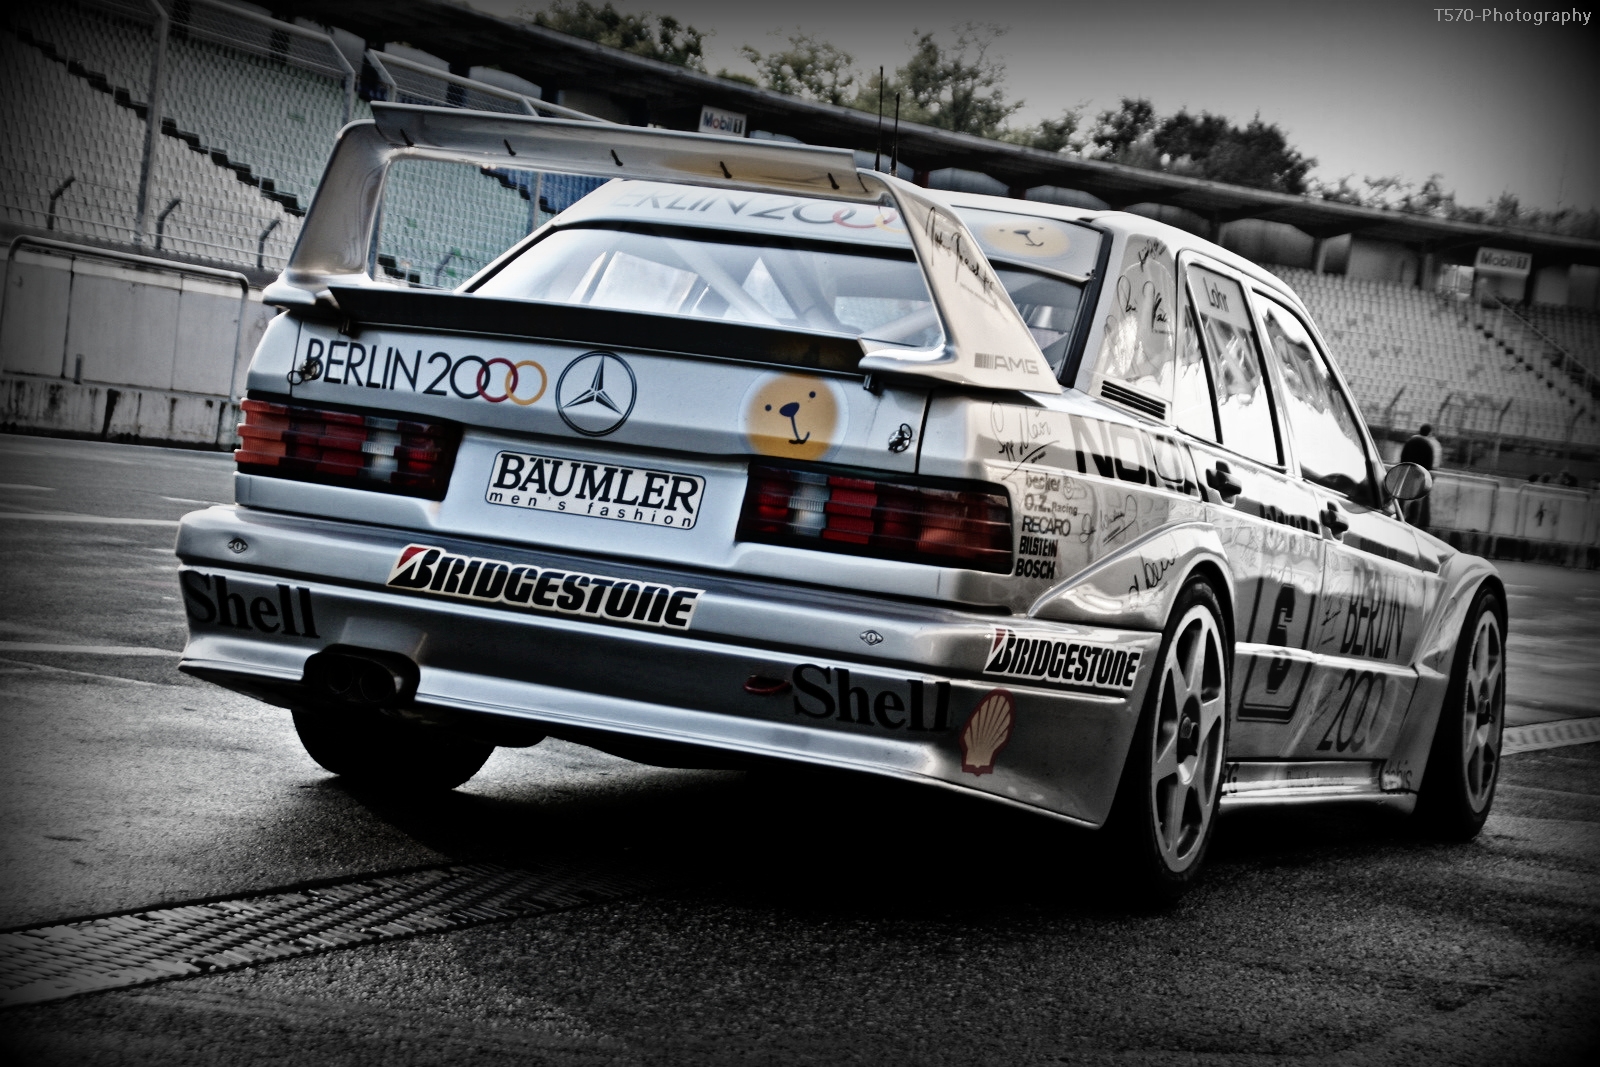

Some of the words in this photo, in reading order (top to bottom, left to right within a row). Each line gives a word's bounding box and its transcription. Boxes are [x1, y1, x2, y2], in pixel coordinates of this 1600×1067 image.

[703, 111, 733, 132] Mobil
[1202, 276, 1229, 313] Lohr
[994, 354, 1040, 375] AMG
[492, 453, 700, 514] BÄUMLER
[1025, 470, 1061, 493] becker
[488, 491, 568, 511] men's
[587, 502, 693, 528] fashion
[1051, 503, 1078, 517] Racing
[1021, 515, 1071, 537] RECARO
[1018, 535, 1059, 558] BILSTEIN
[1014, 558, 1056, 579] BOSCH
[393, 548, 700, 628] BRIDGESTONE
[179, 570, 321, 639] Shell
[988, 628, 1141, 688] BRIDGESTONE
[792, 663, 951, 731] Shell
